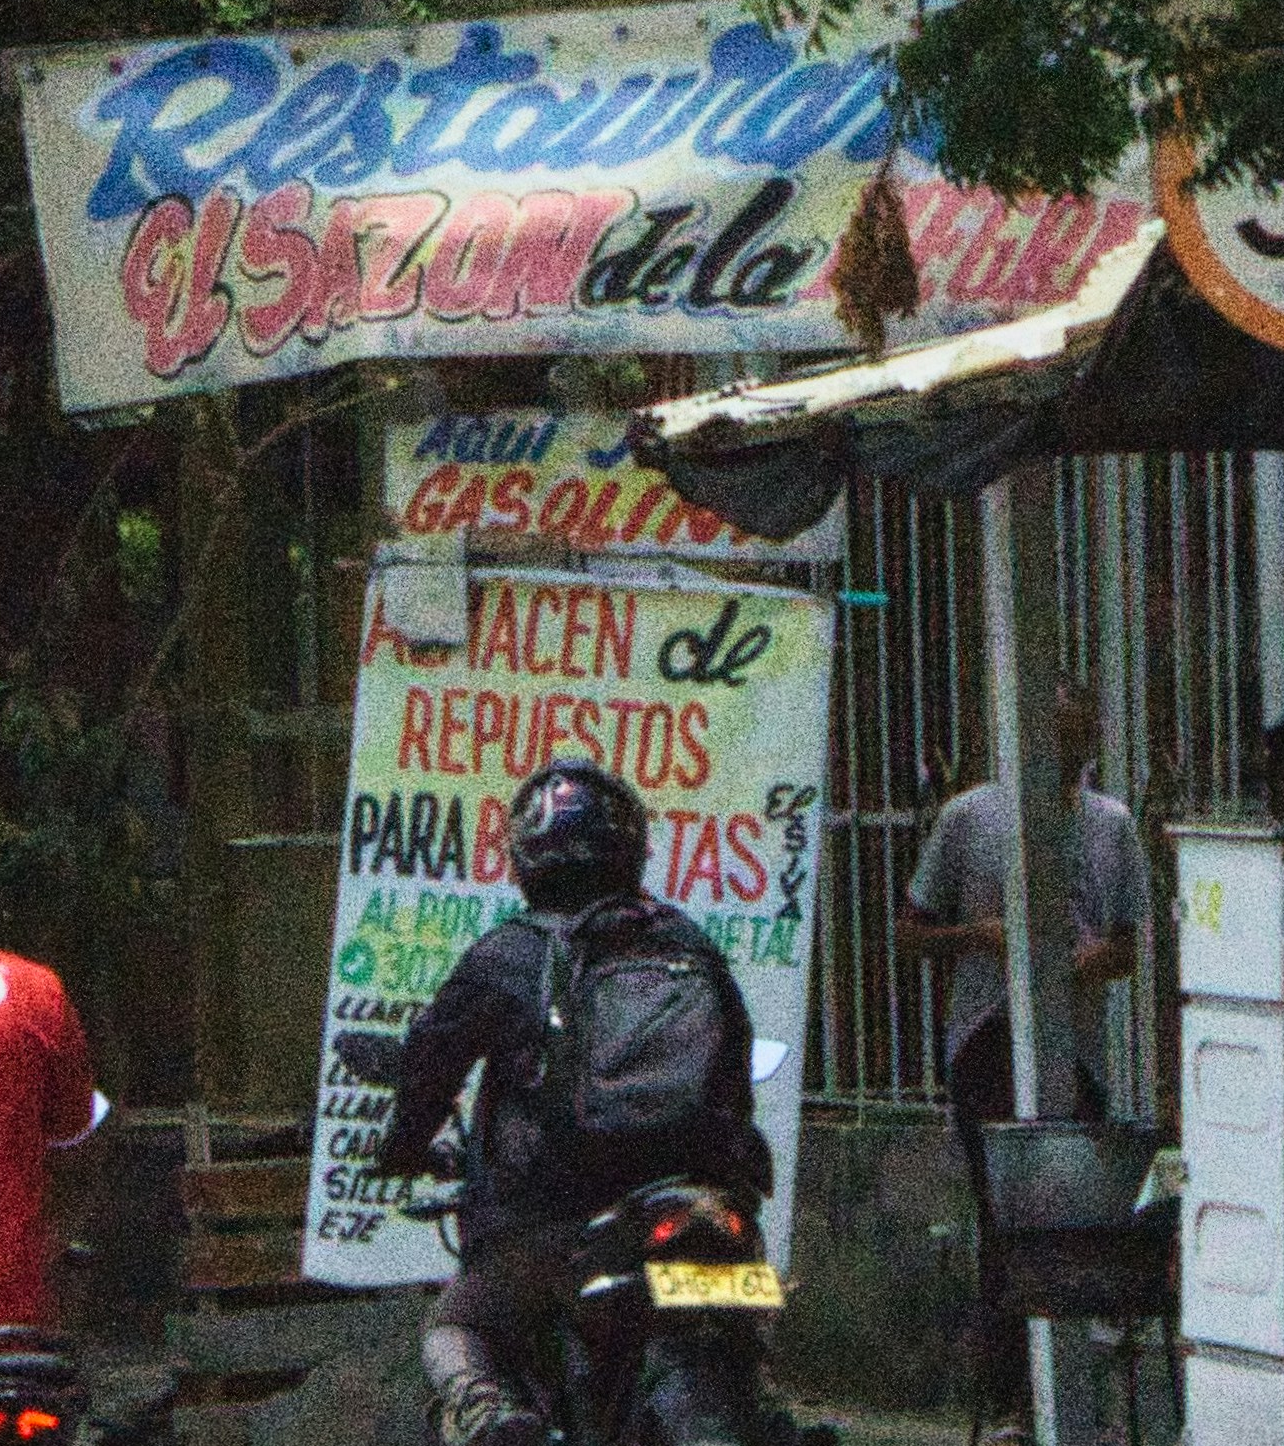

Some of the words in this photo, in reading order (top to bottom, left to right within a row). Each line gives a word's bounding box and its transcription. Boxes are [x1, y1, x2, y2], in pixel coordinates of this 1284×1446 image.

[404, 463, 772, 548] GASOLIN
[657, 598, 772, 686] de
[397, 686, 713, 792] REPUESTOS
[349, 793, 467, 881] PARA
